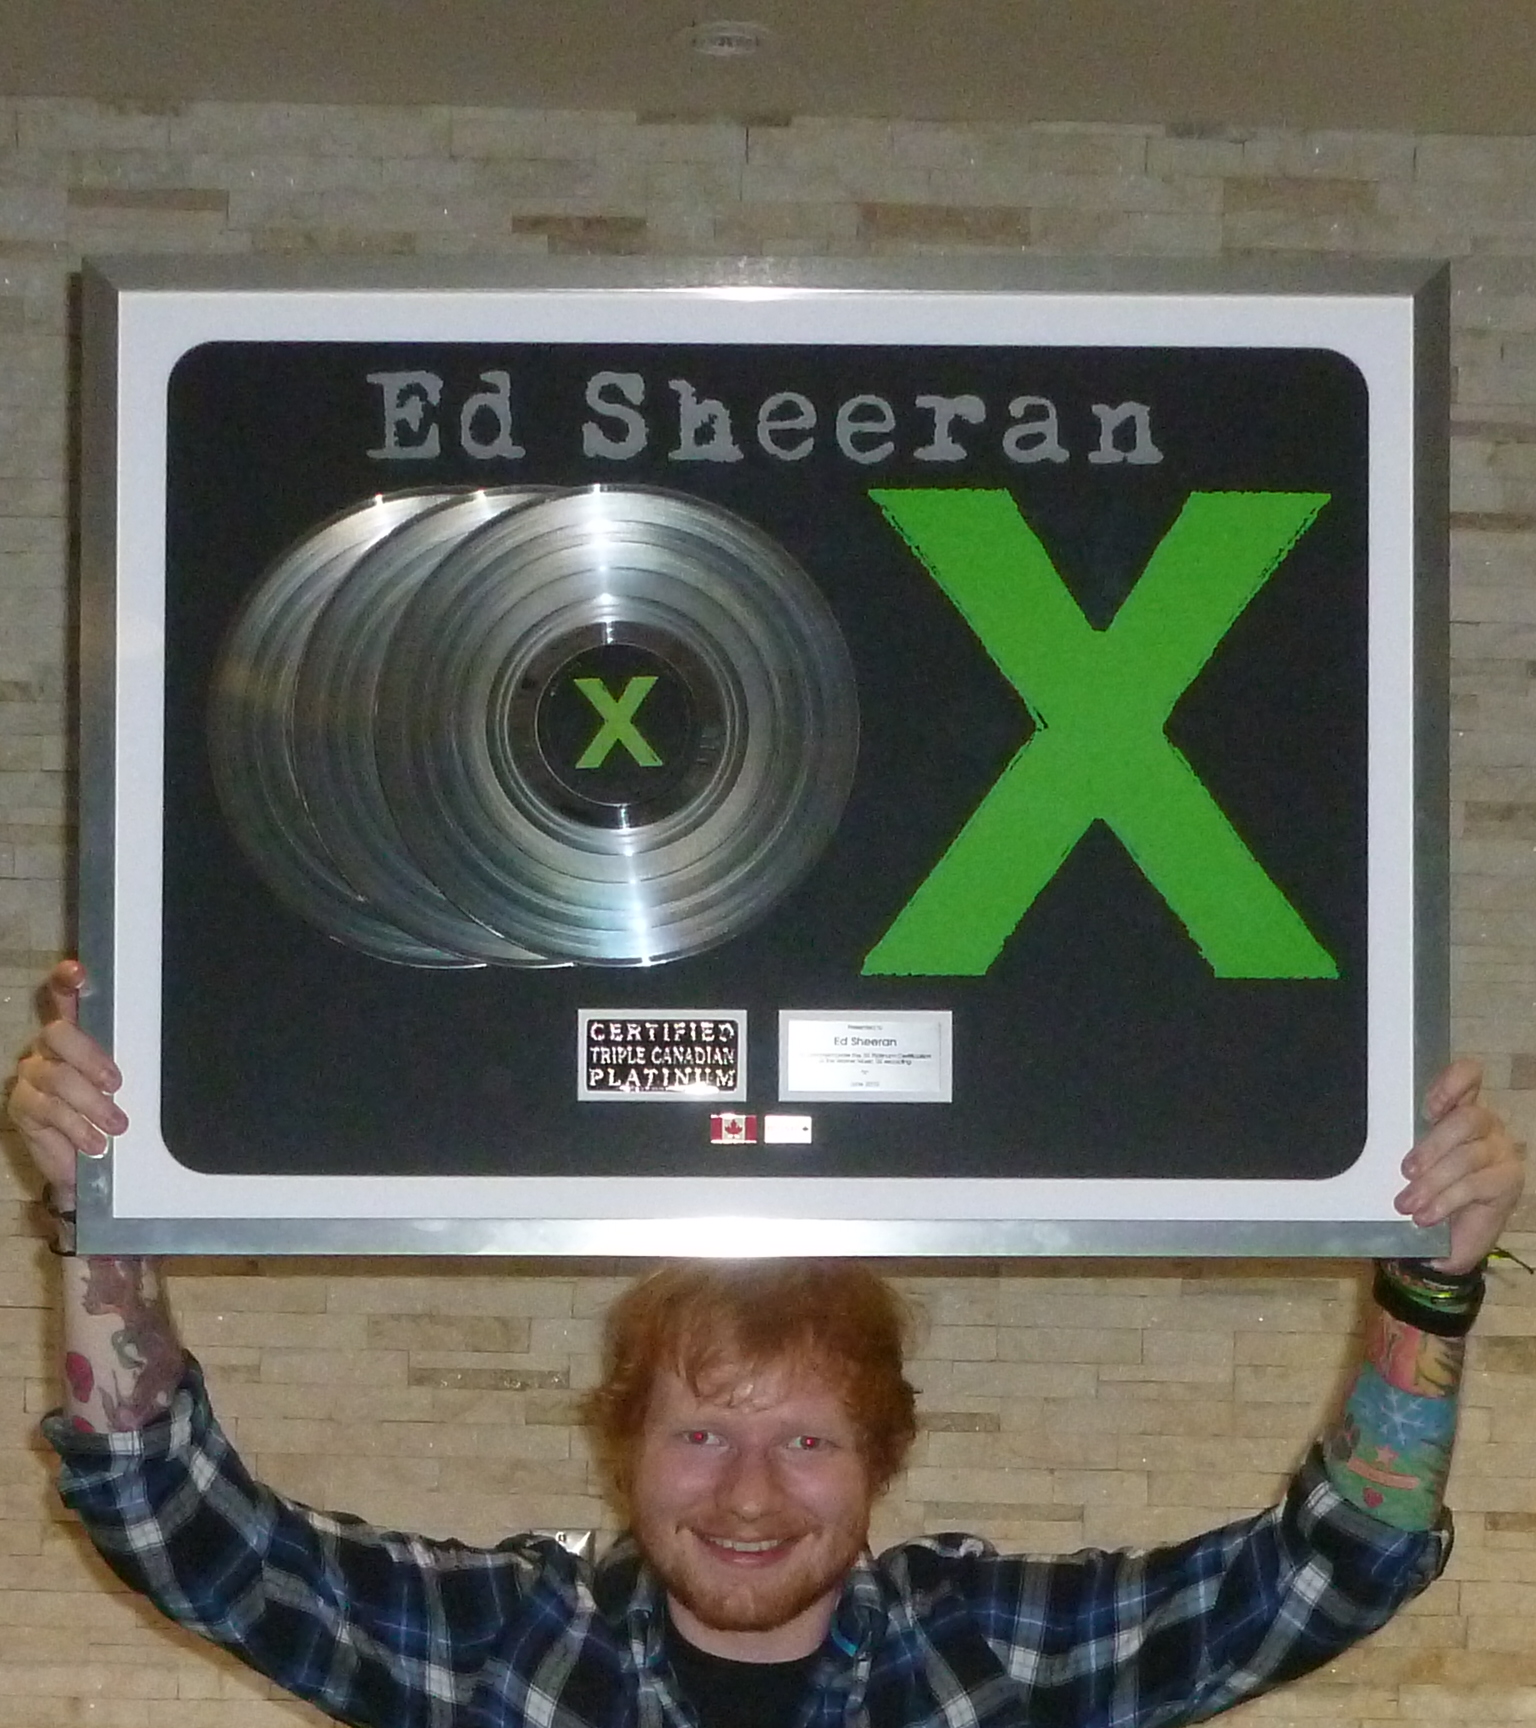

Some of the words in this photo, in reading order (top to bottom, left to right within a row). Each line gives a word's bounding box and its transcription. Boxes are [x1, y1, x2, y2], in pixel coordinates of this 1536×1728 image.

[366, 369, 524, 462] Ed
[580, 371, 1164, 468] Sheeran
[589, 1021, 735, 1042] CERTIFIED
[833, 1036, 848, 1046] Ed
[851, 1037, 898, 1048] Sheeran
[589, 1046, 646, 1064] TRIPLE
[651, 1046, 735, 1065] CANADIAN
[589, 1067, 736, 1087] PLATINUM
